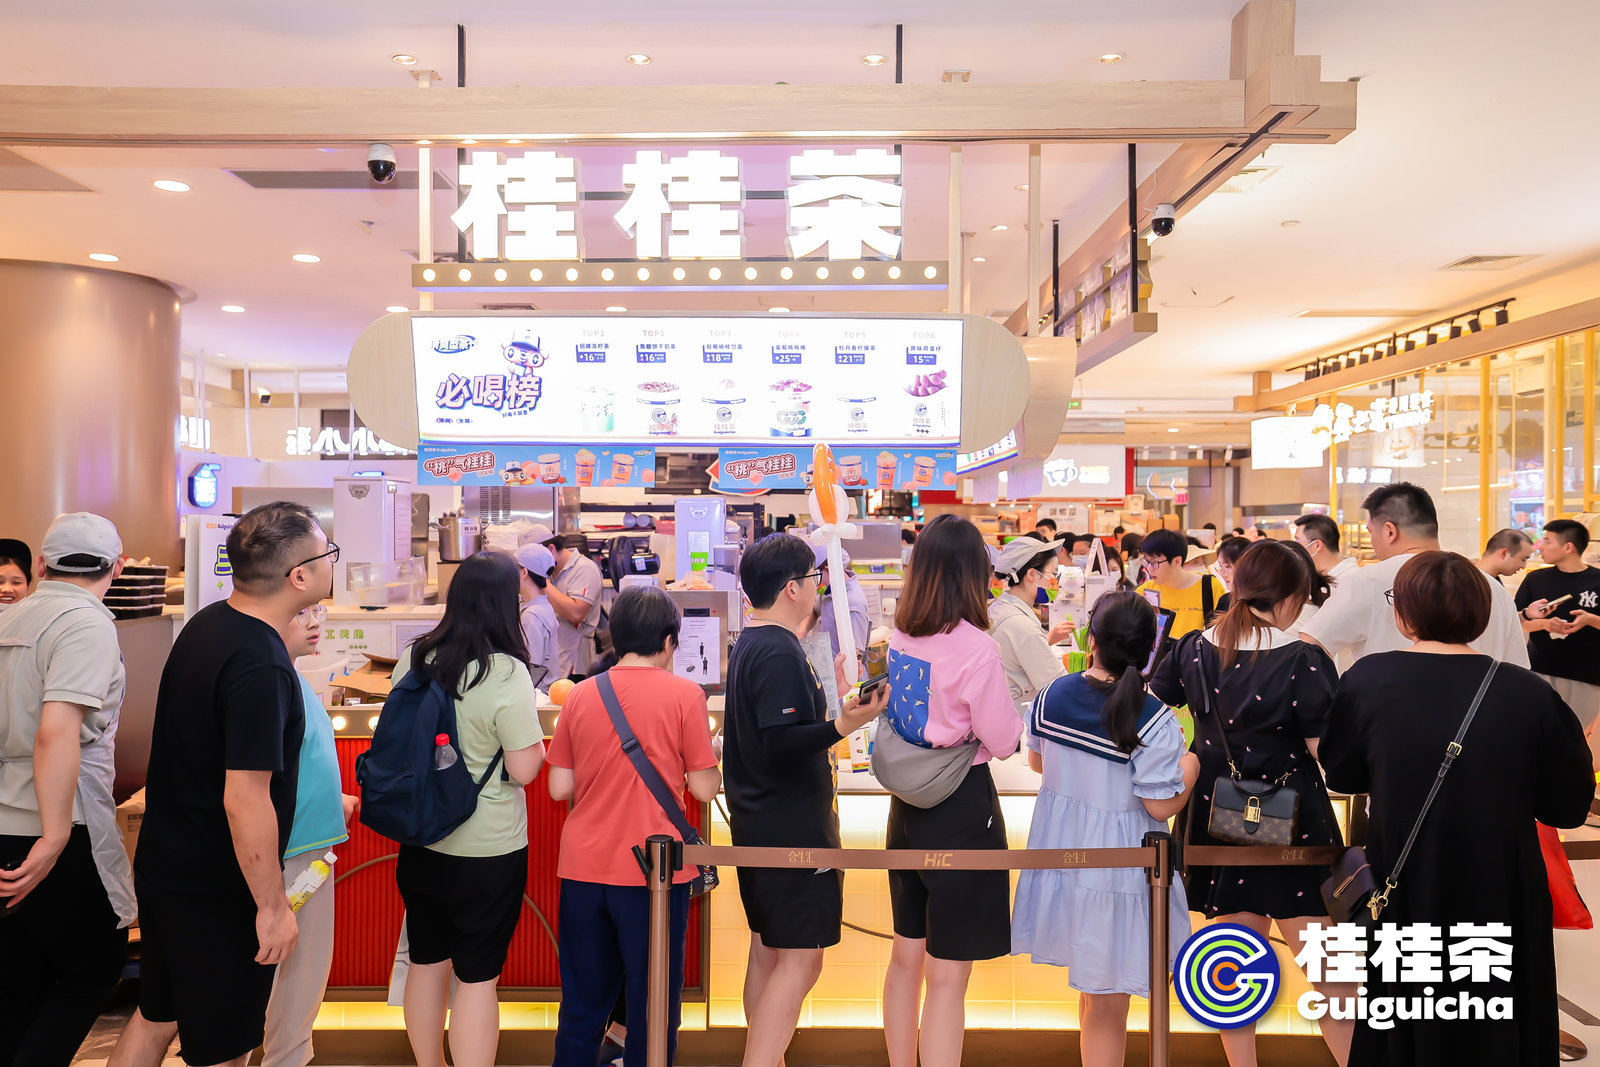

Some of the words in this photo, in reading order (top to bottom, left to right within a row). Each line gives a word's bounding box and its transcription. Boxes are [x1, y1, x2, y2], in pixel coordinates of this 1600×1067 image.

[450, 149, 905, 261] 桂桂茶
[584, 353, 595, 362] 16
[644, 353, 655, 362] 16
[711, 354, 722, 362] 18
[779, 354, 790, 363] 25
[842, 355, 853, 363] 21
[913, 355, 924, 364] 15
[435, 373, 542, 411] 必喝榜
